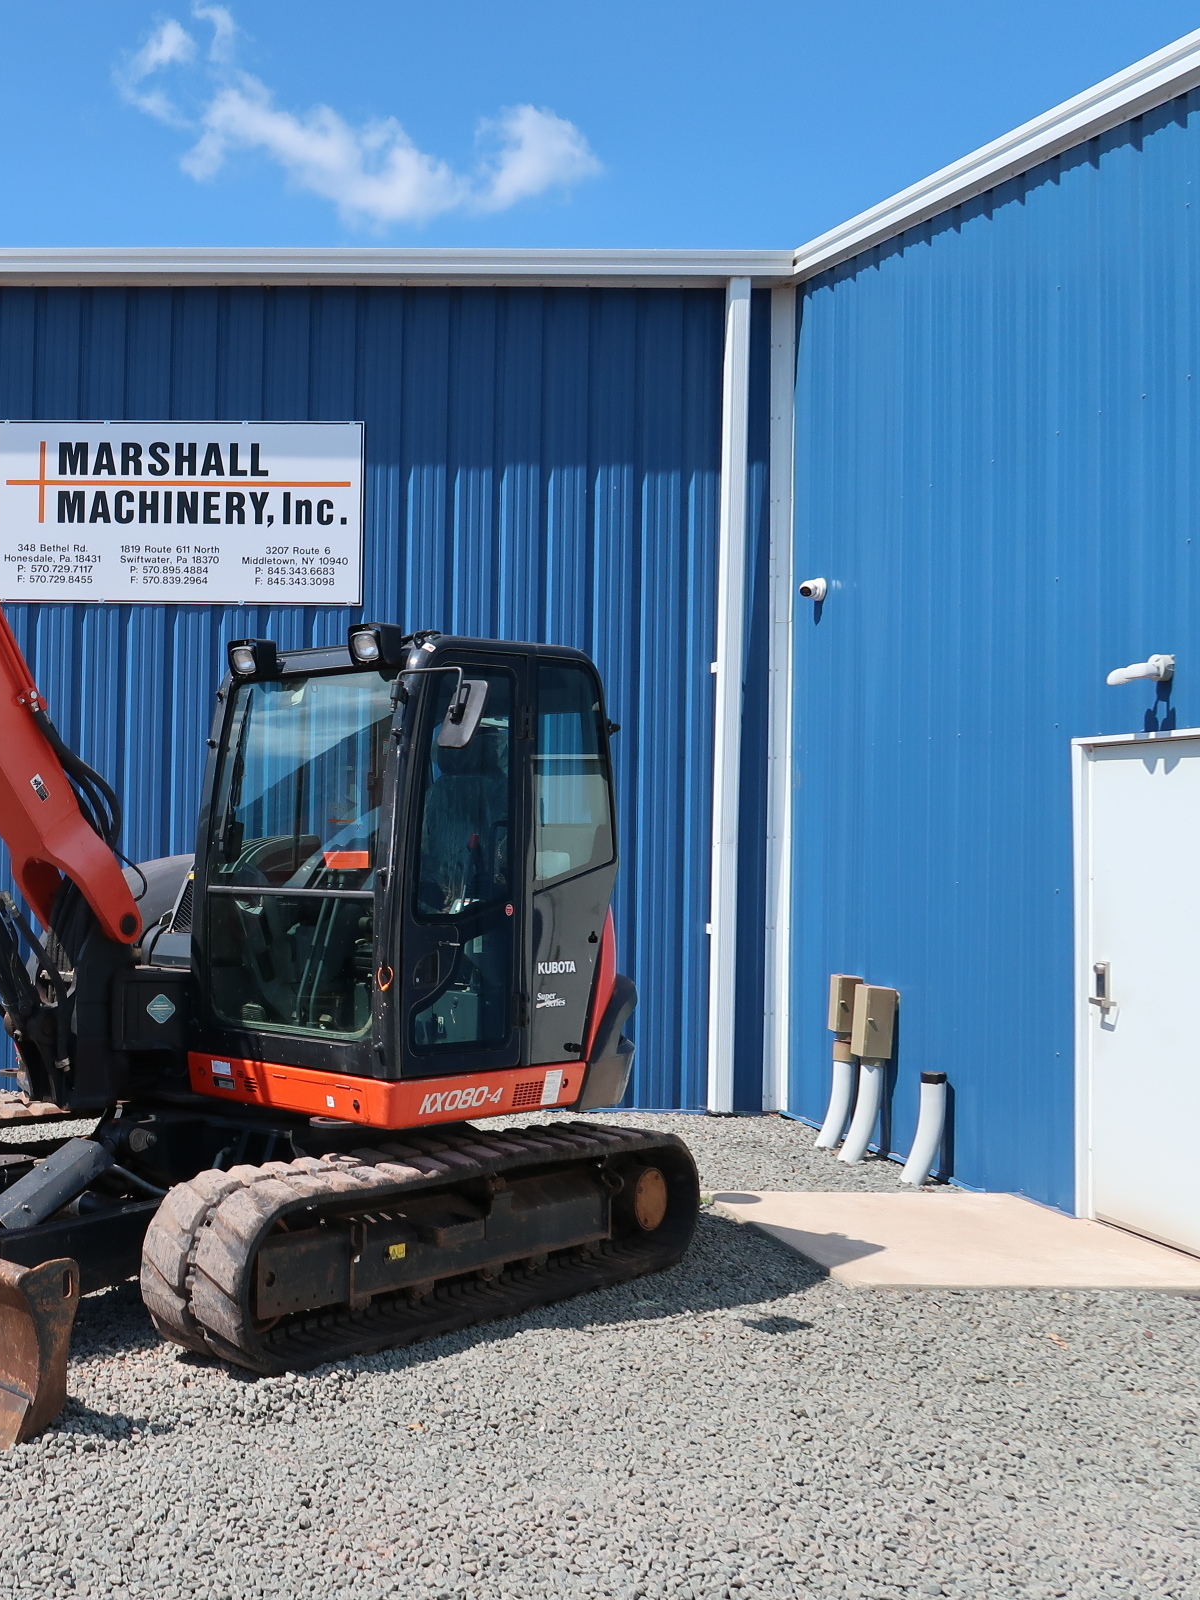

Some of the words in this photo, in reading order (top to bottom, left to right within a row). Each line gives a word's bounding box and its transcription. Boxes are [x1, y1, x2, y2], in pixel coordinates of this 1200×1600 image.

[57, 441, 269, 477] MARSHALL
[57, 490, 275, 528] MACHINERY,
[282, 491, 348, 526] Inc.
[17, 543, 36, 552] 348
[40, 544, 70, 552] Bethel
[73, 544, 88, 553] Rd.
[120, 545, 141, 554] 1819
[144, 545, 172, 554] Route
[176, 545, 190, 554] 611
[194, 546, 220, 554] North
[265, 546, 289, 555] 3207
[293, 547, 319, 555] Route
[324, 546, 331, 555] 6
[4, 554, 56, 563] Honesdale,
[59, 554, 72, 563] Pa.
[74, 554, 101, 563] 18431
[120, 555, 173, 565] Swiftwater,
[176, 556, 188, 564] Pa
[191, 556, 220, 564] 18370
[241, 556, 298, 566] Middletown,
[301, 557, 315, 565] NY
[319, 557, 349, 566] 10940
[17, 564, 26, 573] P:
[30, 564, 93, 573] 570.729.7117
[130, 566, 139, 574] P:
[142, 566, 209, 574] 570.895.4884
[254, 567, 263, 575] P:
[267, 567, 335, 575] 845.343.6683
[17, 575, 26, 583] F:
[29, 575, 93, 584] 570.729.8455
[130, 576, 139, 584] F:
[142, 576, 208, 585] 570.839.2964
[254, 577, 263, 585] F:
[266, 577, 335, 586] 845.343.3098
[537, 960, 576, 975] KUBOTA
[537, 992, 557, 1001] Super
[417, 1085, 504, 1115] KX080-4
